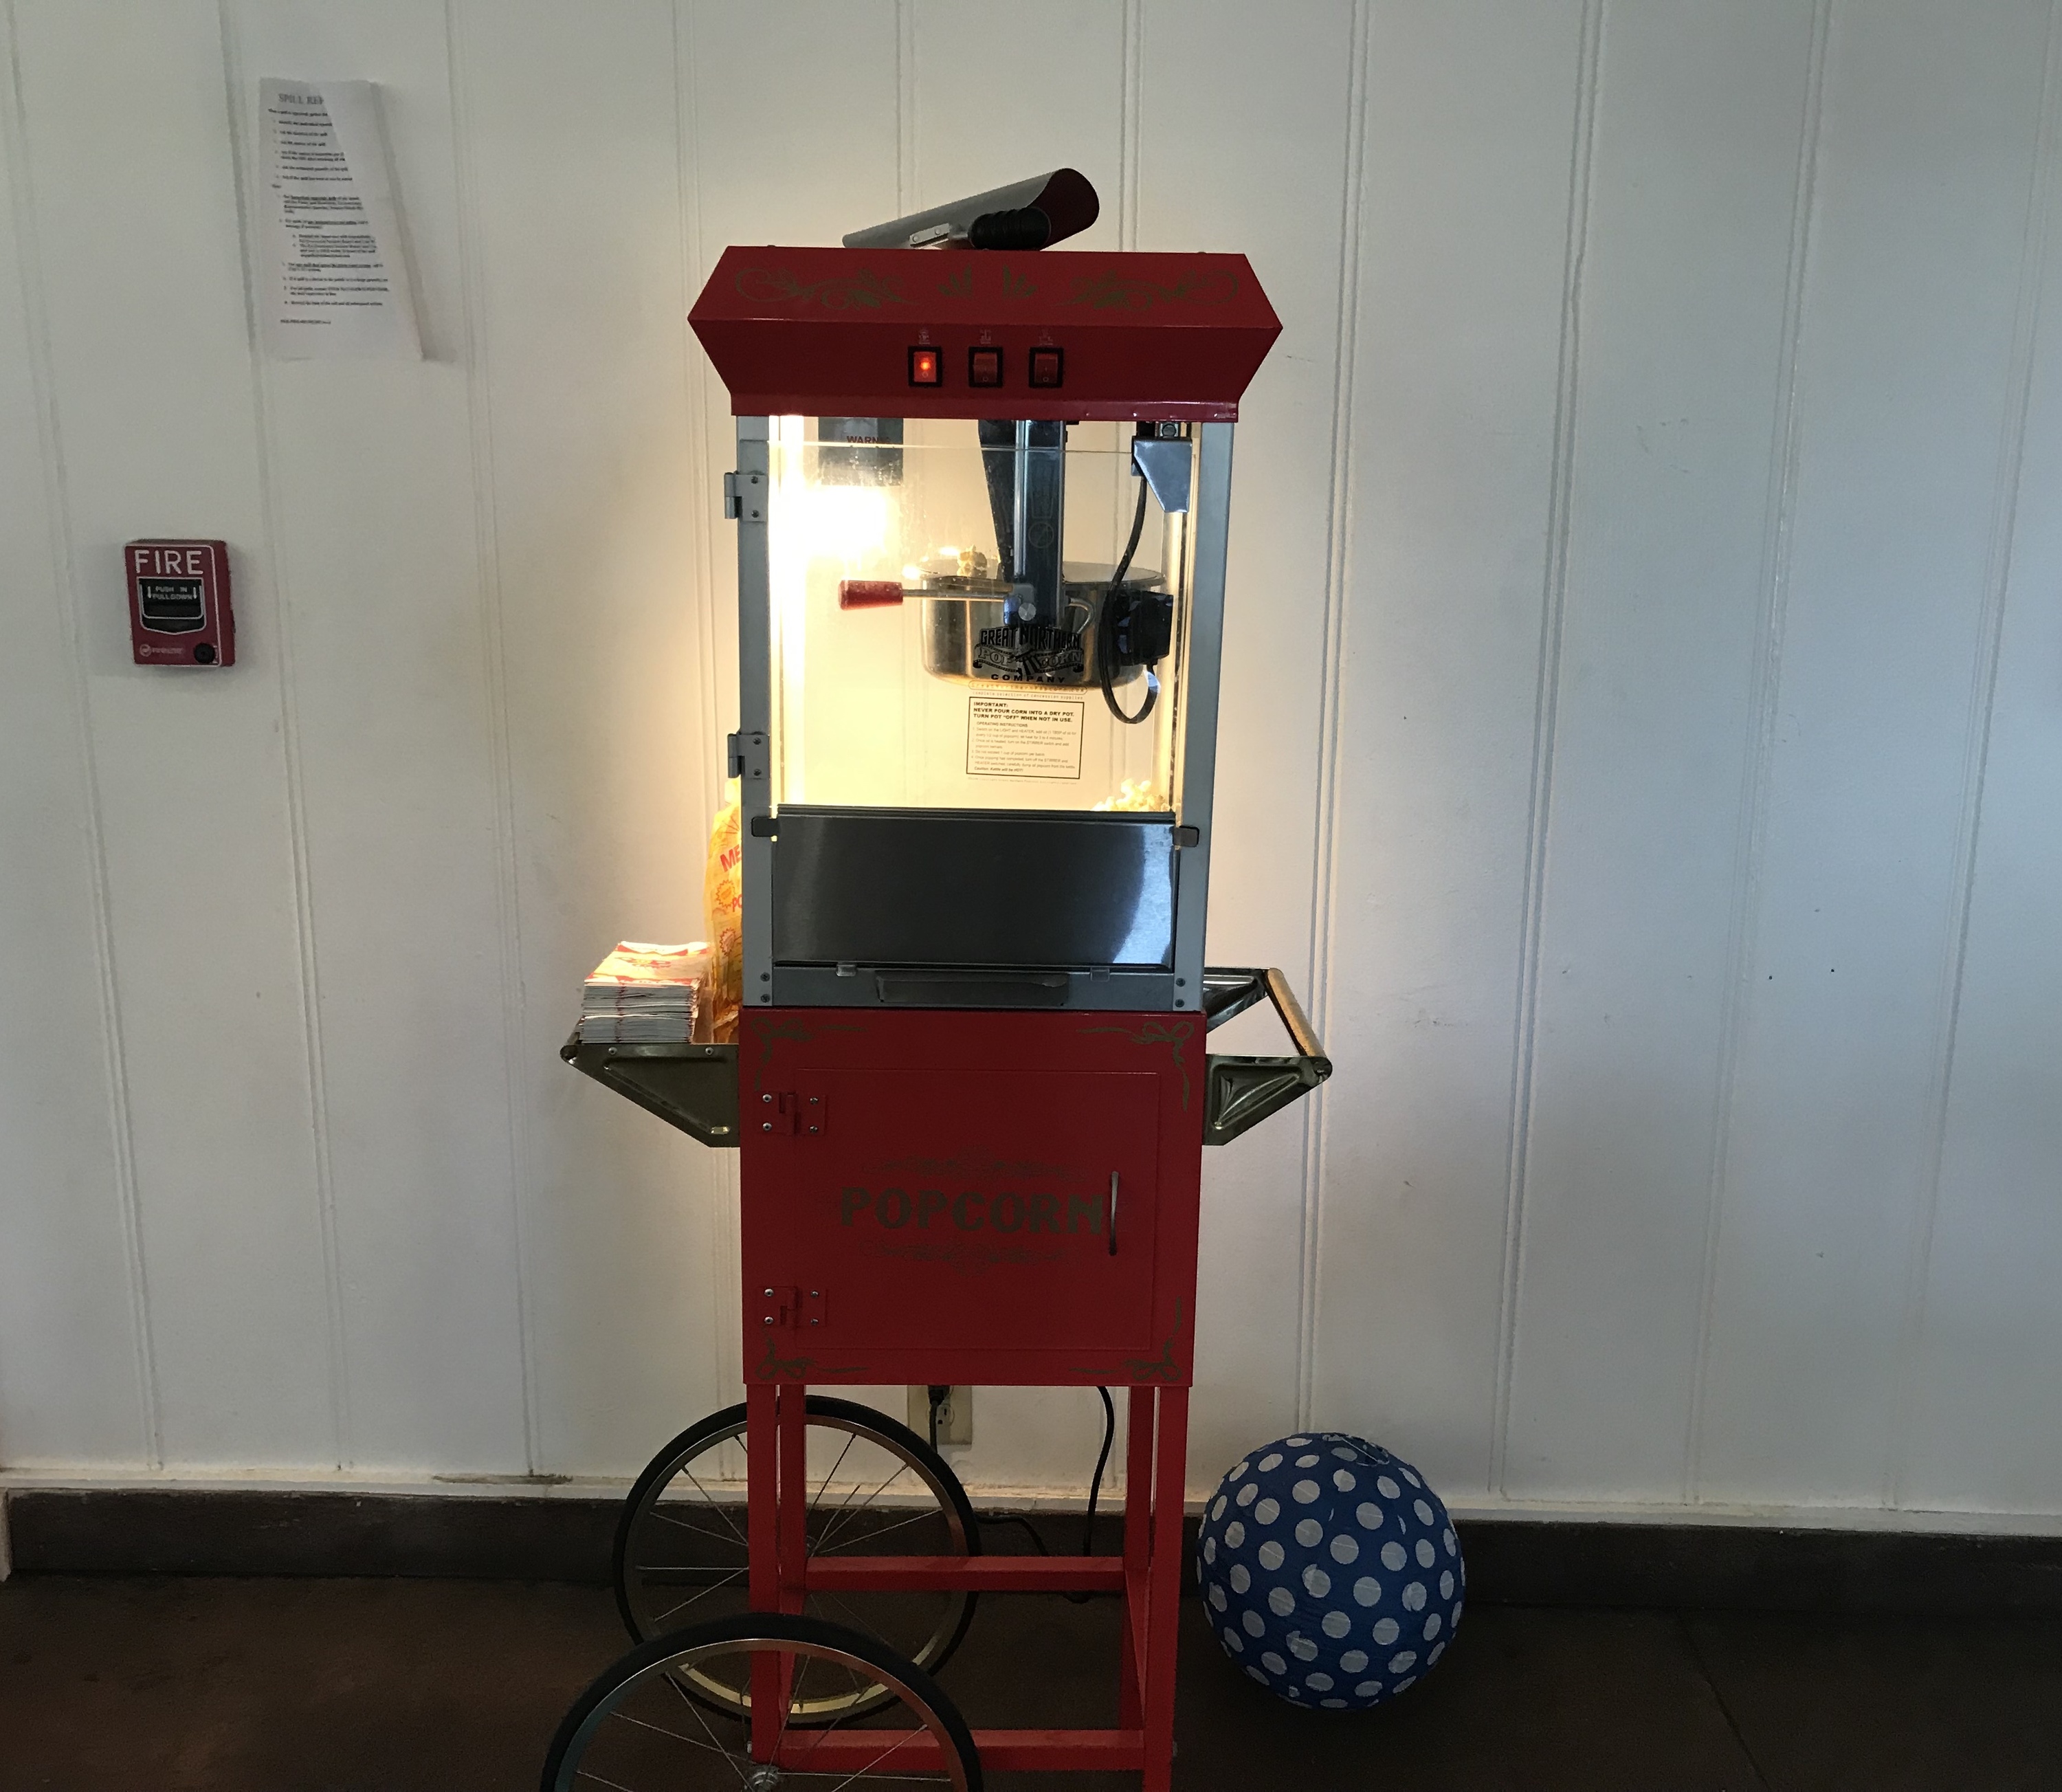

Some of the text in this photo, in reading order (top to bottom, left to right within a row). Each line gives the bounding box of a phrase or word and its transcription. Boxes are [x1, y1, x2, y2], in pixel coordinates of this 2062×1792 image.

[135, 549, 204, 575] FIRE
[980, 624, 1082, 651] GREAT NORTHERN
[1040, 651, 1083, 670] CORN
[991, 674, 1065, 683] COMPANY
[841, 1186, 1102, 1235] POPCORN
